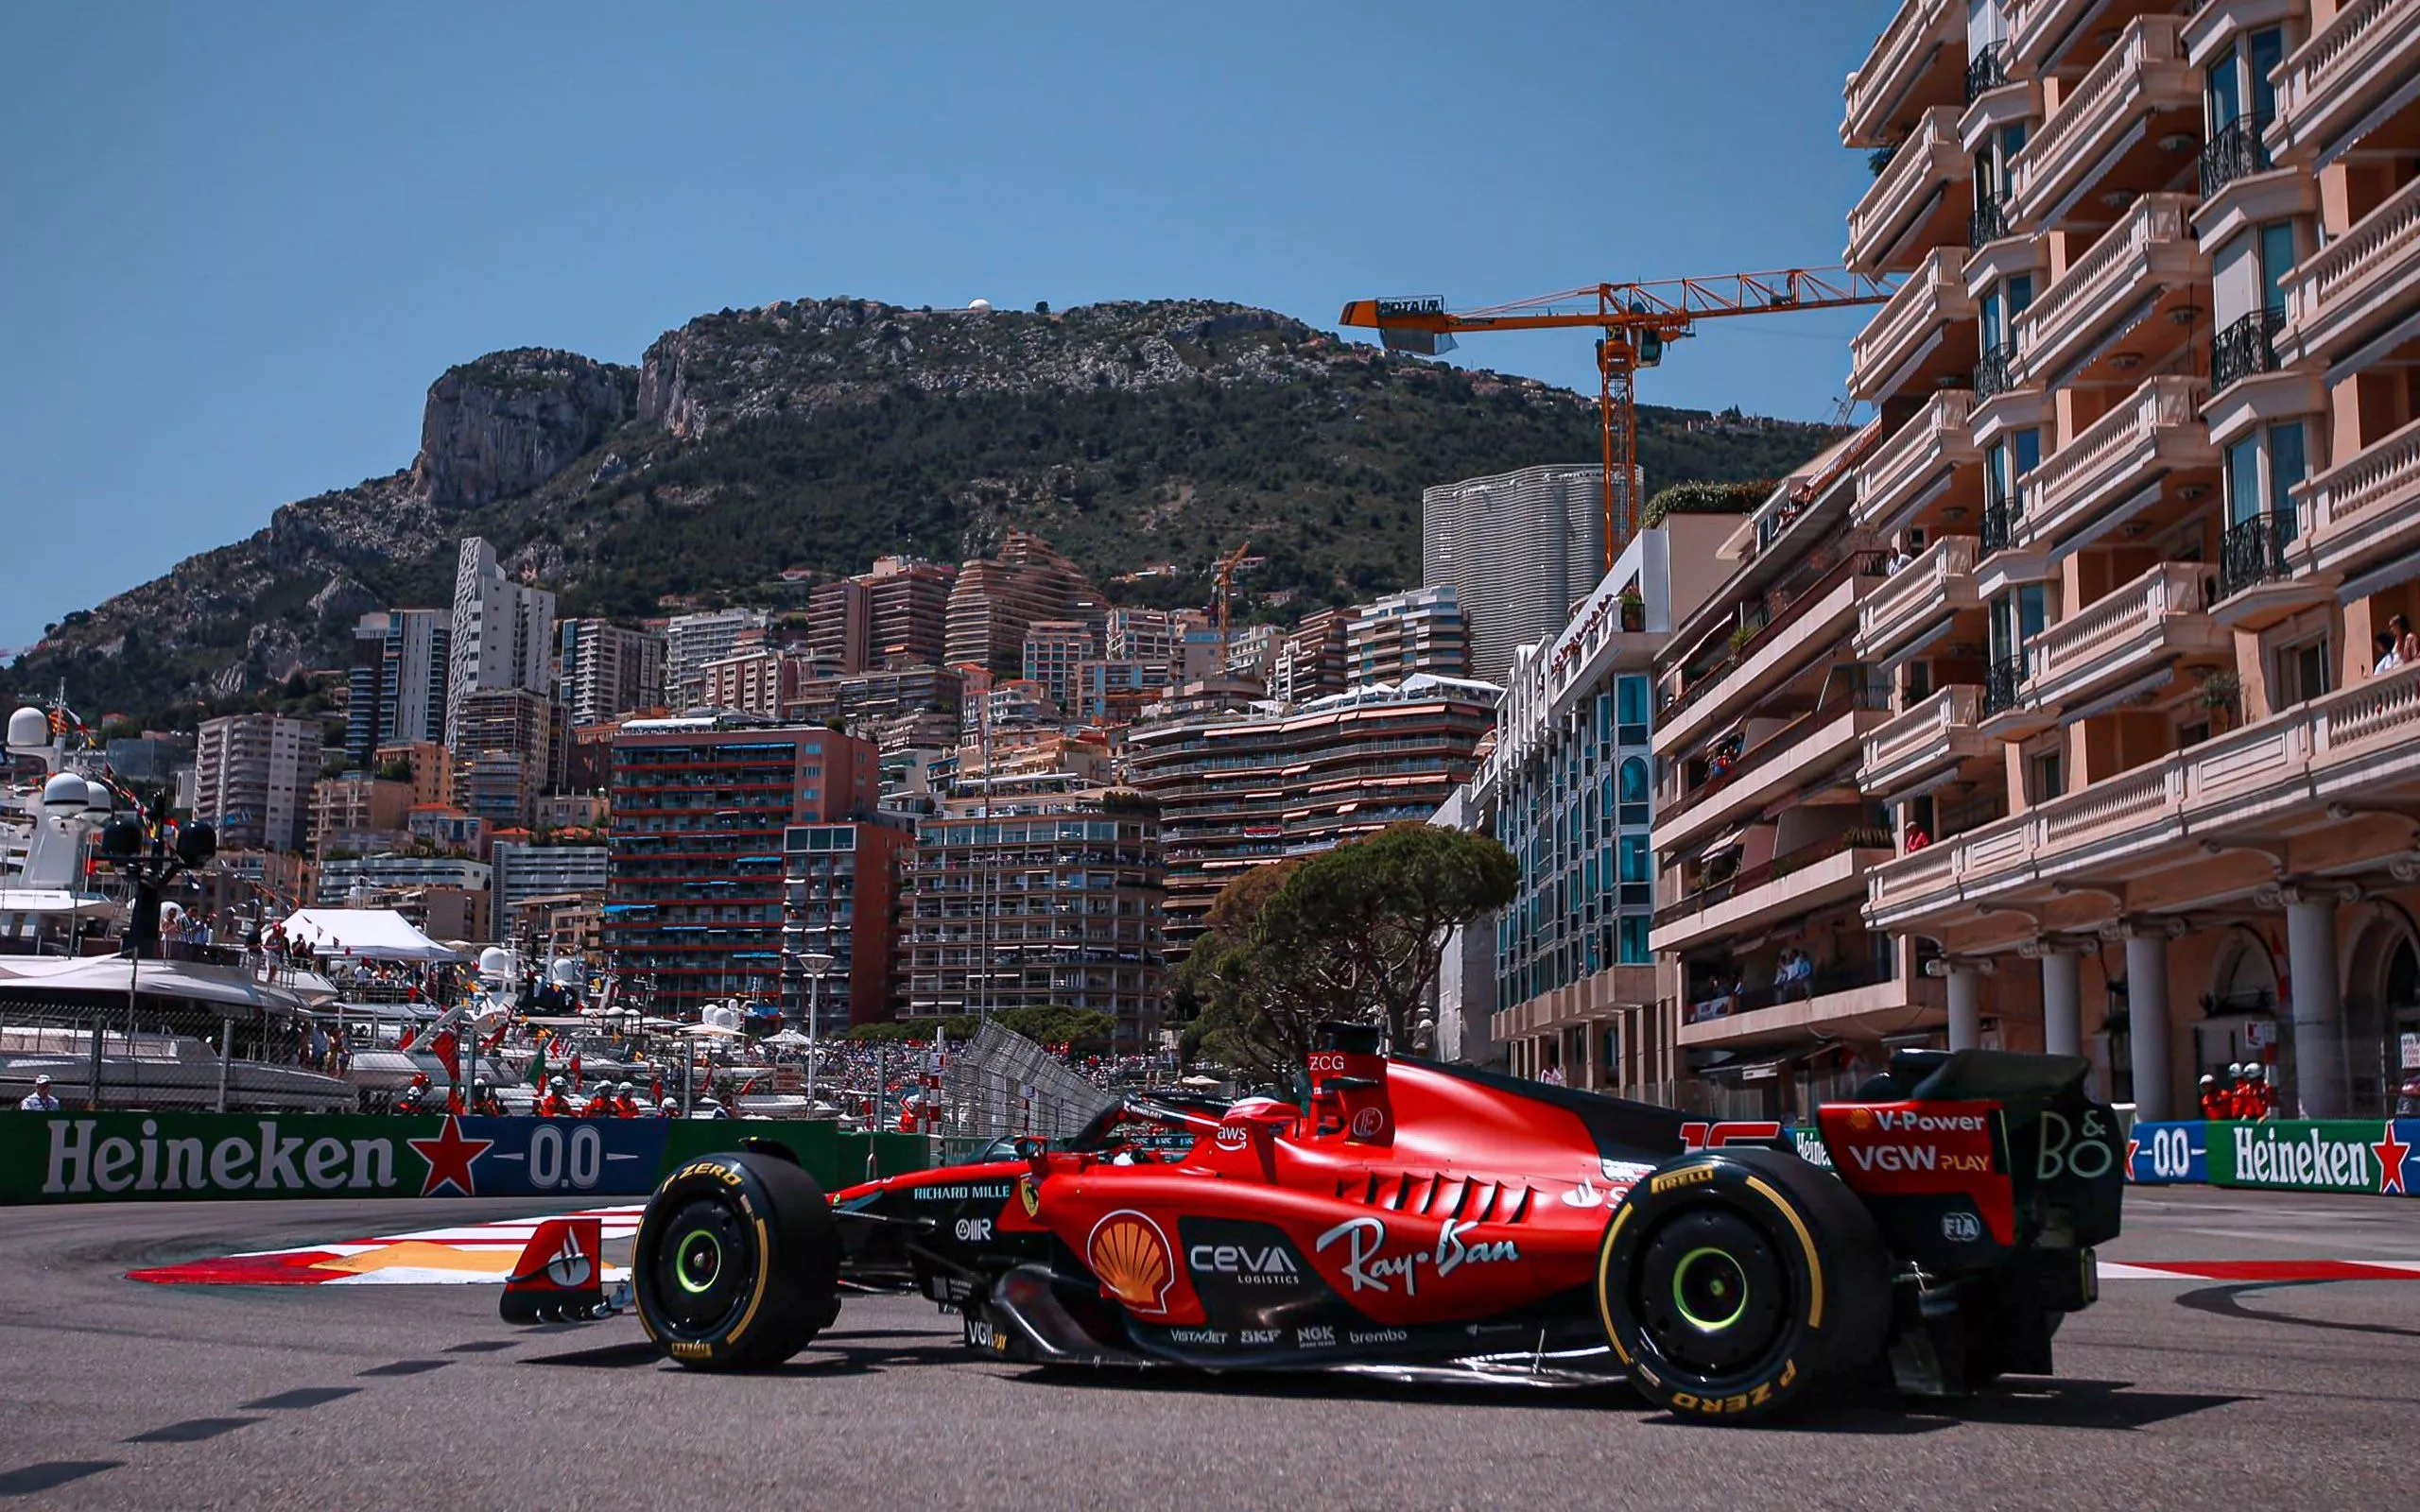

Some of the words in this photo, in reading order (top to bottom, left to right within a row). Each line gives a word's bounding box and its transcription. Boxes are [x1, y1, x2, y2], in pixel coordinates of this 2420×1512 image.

[1309, 1056, 1344, 1071] ZCG
[1218, 1125, 1247, 1140] aws
[1876, 1109, 1984, 1131] V-Power
[43, 1119, 398, 1194] Heineken
[530, 1125, 600, 1188] 0.0
[1796, 1132, 1832, 1166] Heine
[1849, 1145, 1936, 1171] VGW
[1941, 1155, 1989, 1171] PLAY
[2153, 1127, 2189, 1177] 0.0
[2234, 1127, 2370, 1186] Heineken
[679, 1162, 742, 1185] ZERO
[1651, 1163, 1714, 1194] PIRELLI
[914, 1187, 968, 1200] RICHARD
[972, 1185, 1011, 1198] MILLE
[1237, 1275, 1300, 1285] LOGISTICS
[1349, 1329, 1408, 1343] brembo
[1672, 1382, 1772, 1413] ZERO
